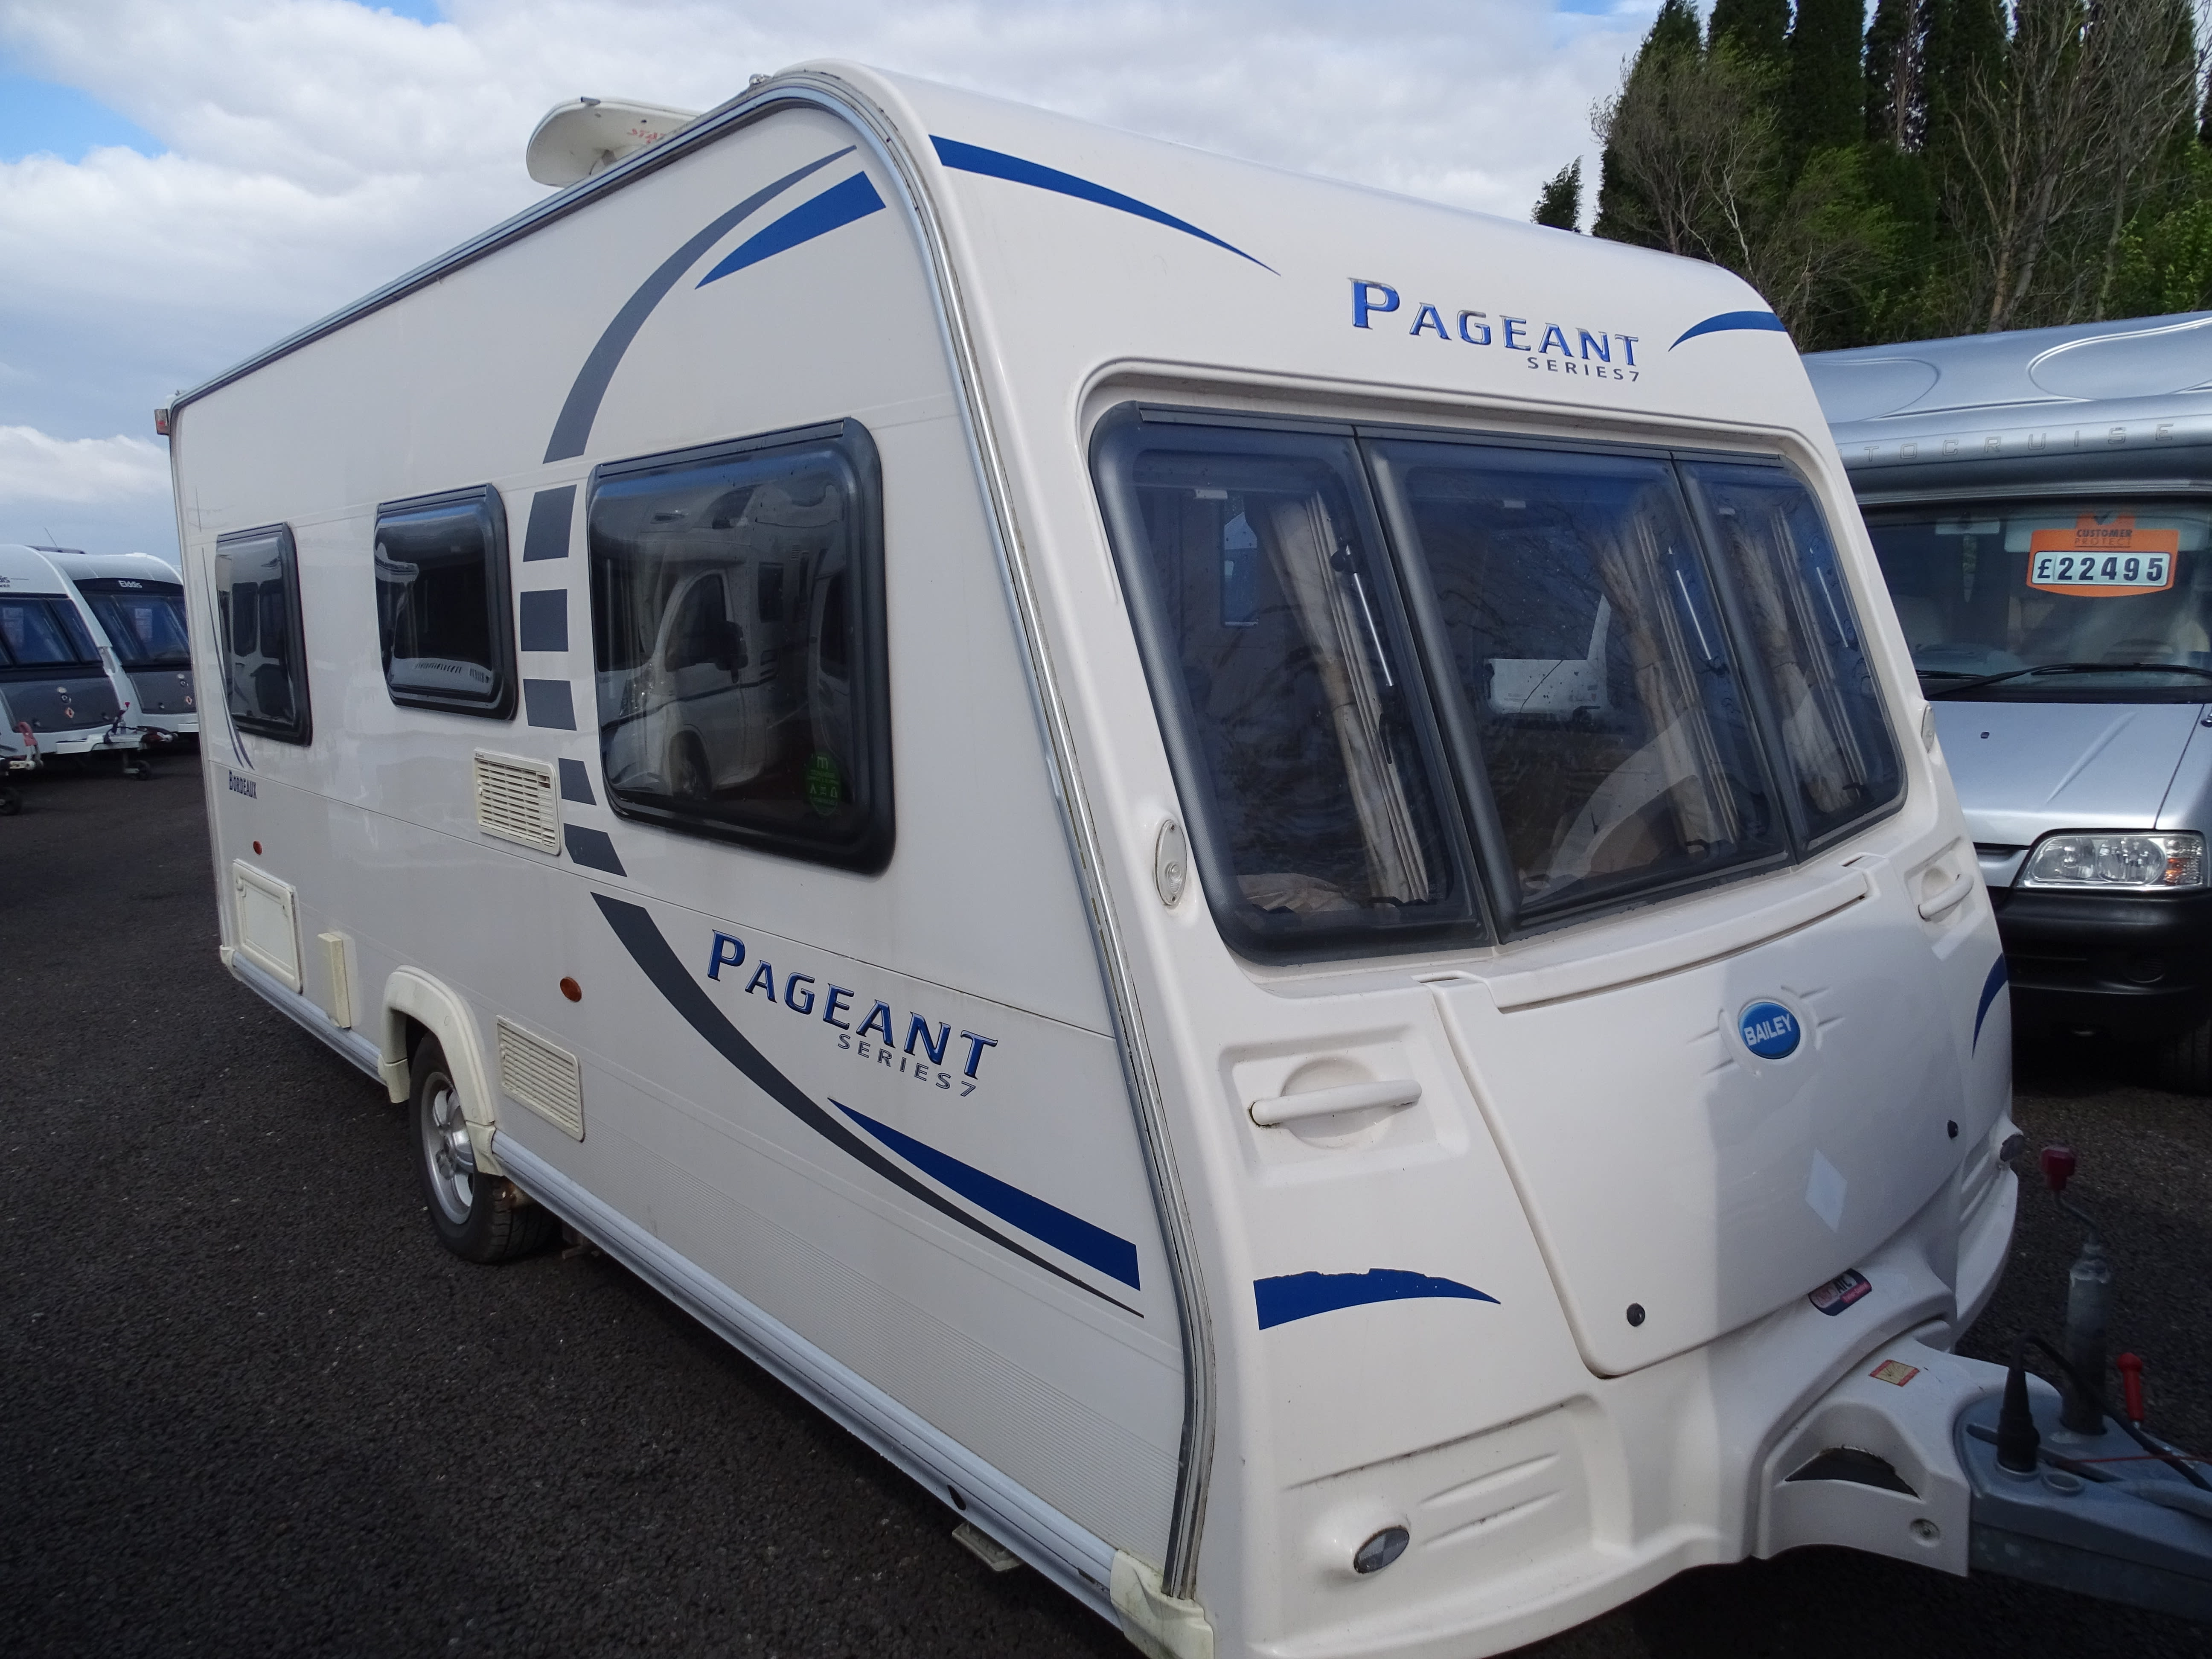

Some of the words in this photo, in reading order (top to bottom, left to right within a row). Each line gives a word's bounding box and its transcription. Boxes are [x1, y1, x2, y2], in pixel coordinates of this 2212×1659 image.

[1348, 278, 1639, 366] PAGEANT
[2076, 529, 2132, 537] CUSTOMER
[2037, 557, 2163, 581] £22495
[229, 770, 257, 799] BORDEAUX
[707, 929, 998, 1080] PAGEANT
[1744, 1013, 1792, 1046] BAILEY
